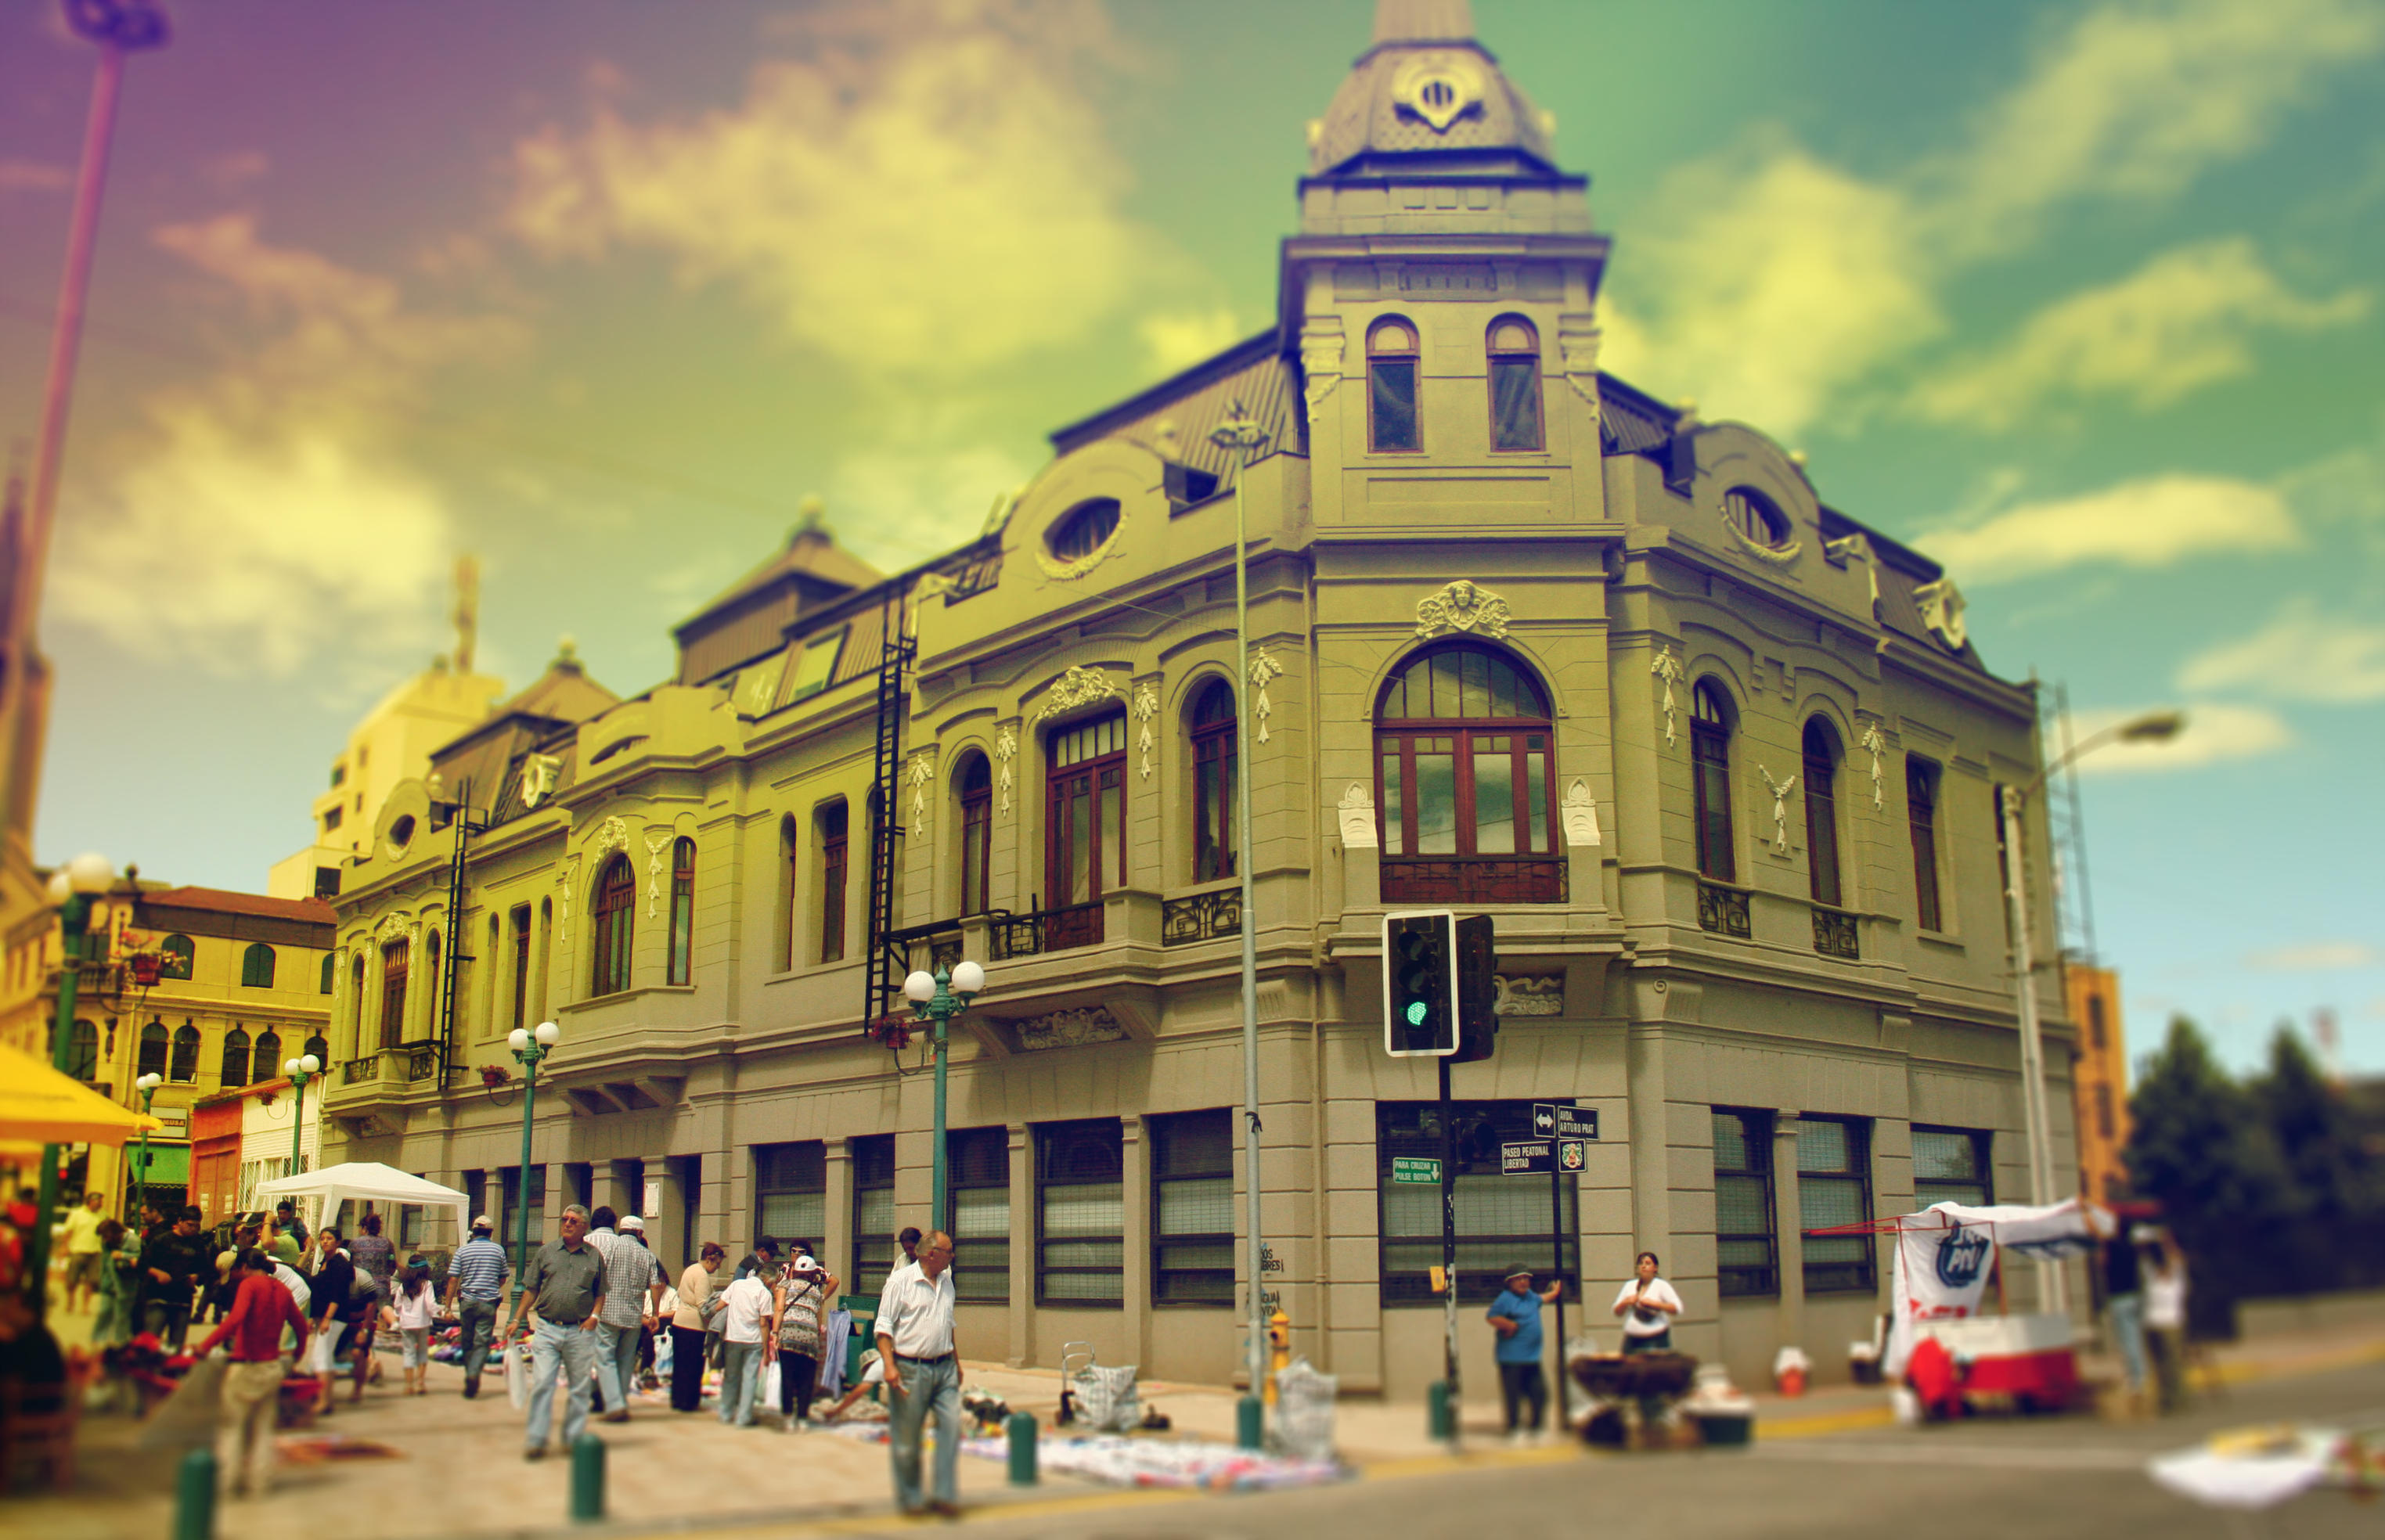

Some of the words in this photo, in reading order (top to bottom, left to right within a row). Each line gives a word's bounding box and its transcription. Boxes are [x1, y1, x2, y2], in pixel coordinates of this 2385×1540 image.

[1559, 1121, 1581, 1133] ARTURO
[1582, 1123, 1594, 1134] PRAT
[1503, 1146, 1521, 1157] PASEO
[1522, 1145, 1550, 1157] PEATONAL
[1395, 1160, 1410, 1169] PARA
[1410, 1161, 1431, 1171] CRUZAR
[1504, 1157, 1529, 1169] LIBERTAD
[1395, 1172, 1412, 1181] PULSE
